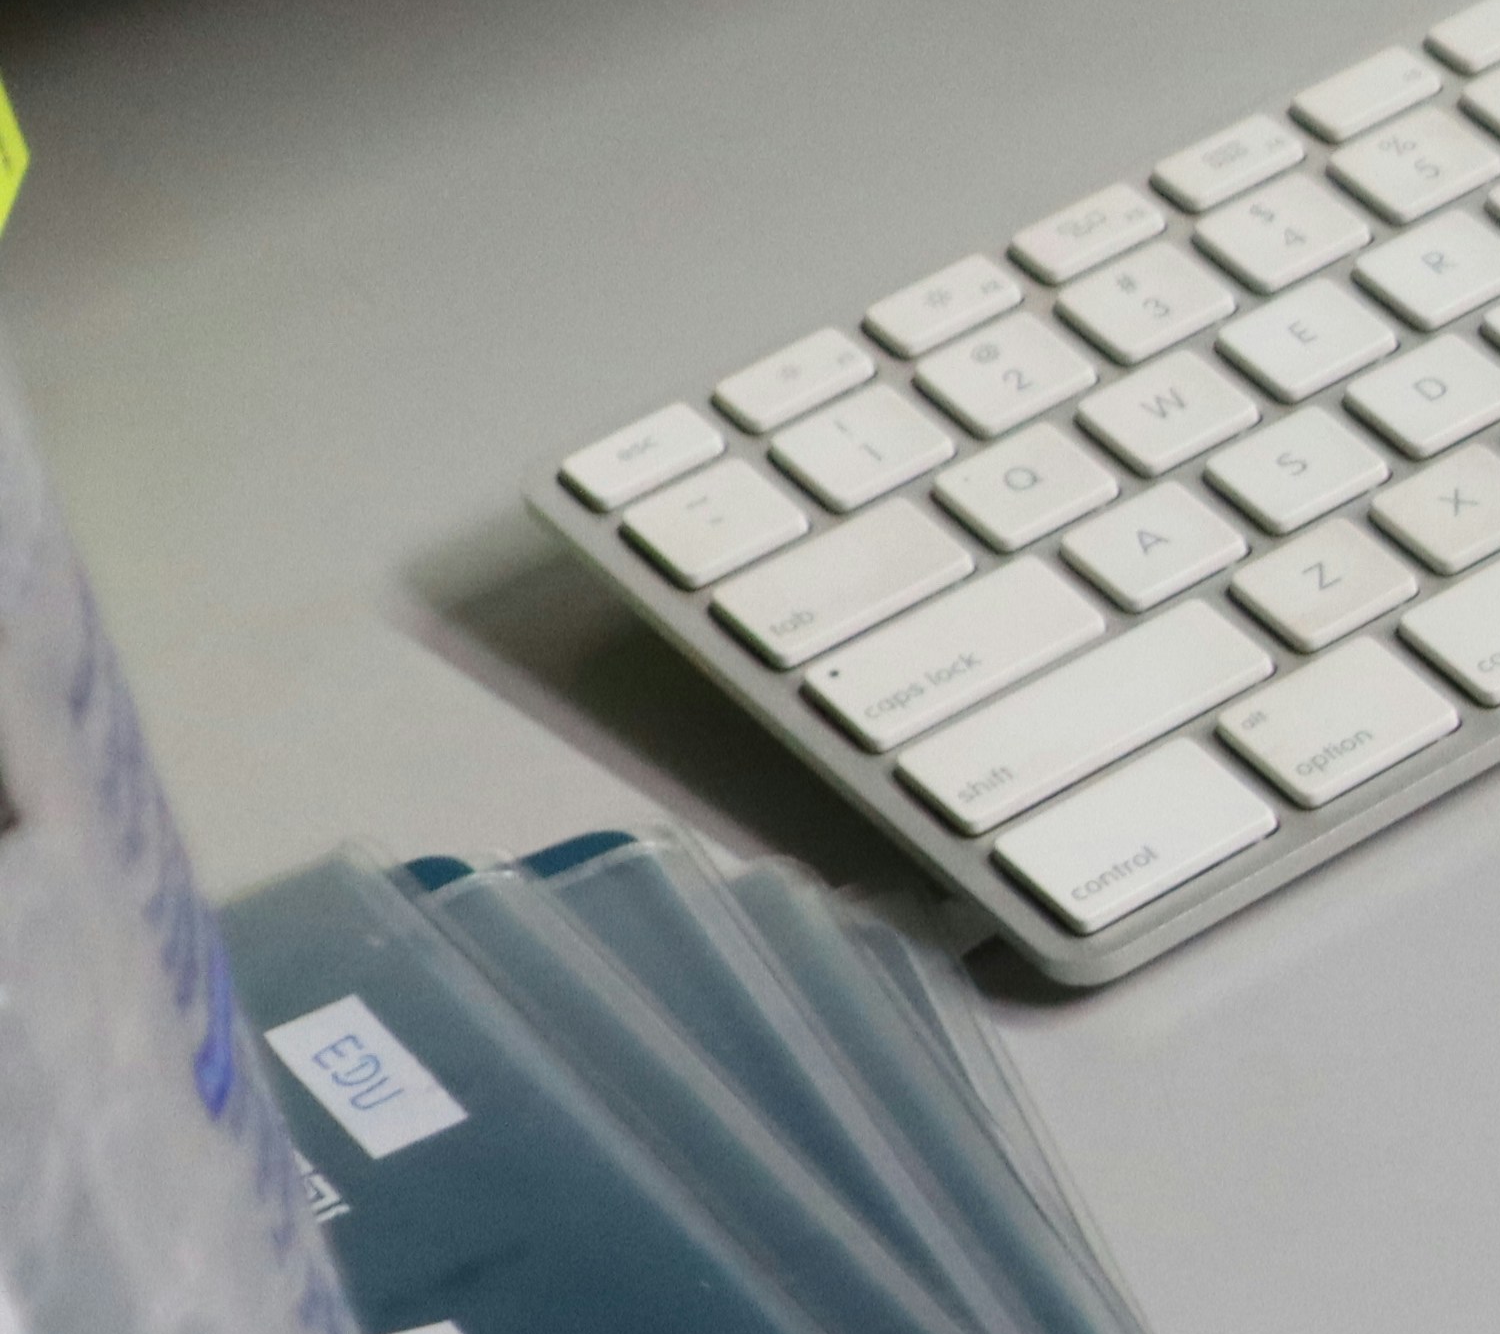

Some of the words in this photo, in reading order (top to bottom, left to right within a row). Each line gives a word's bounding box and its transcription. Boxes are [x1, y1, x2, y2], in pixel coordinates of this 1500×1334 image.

[1415, 158, 1441, 183] 5
[1280, 225, 1306, 250] 4
[1424, 250, 1452, 274] R
[1143, 298, 1171, 322] 3
[1290, 321, 1318, 347] E
[1004, 368, 1034, 392] 2
[1415, 376, 1447, 404] D
[1141, 389, 1187, 421] W
[1276, 450, 1308, 478] S
[1005, 465, 1039, 492] Q
[1441, 489, 1478, 516] X
[1136, 530, 1171, 558] A
[1303, 561, 1342, 593] Z
[768, 608, 814, 640] tab
[862, 678, 922, 723] caps
[924, 649, 981, 694] lock
[1292, 724, 1374, 780] option
[955, 762, 1015, 807] shift
[1068, 843, 1160, 906] control
[311, 1032, 403, 1112] EDU
